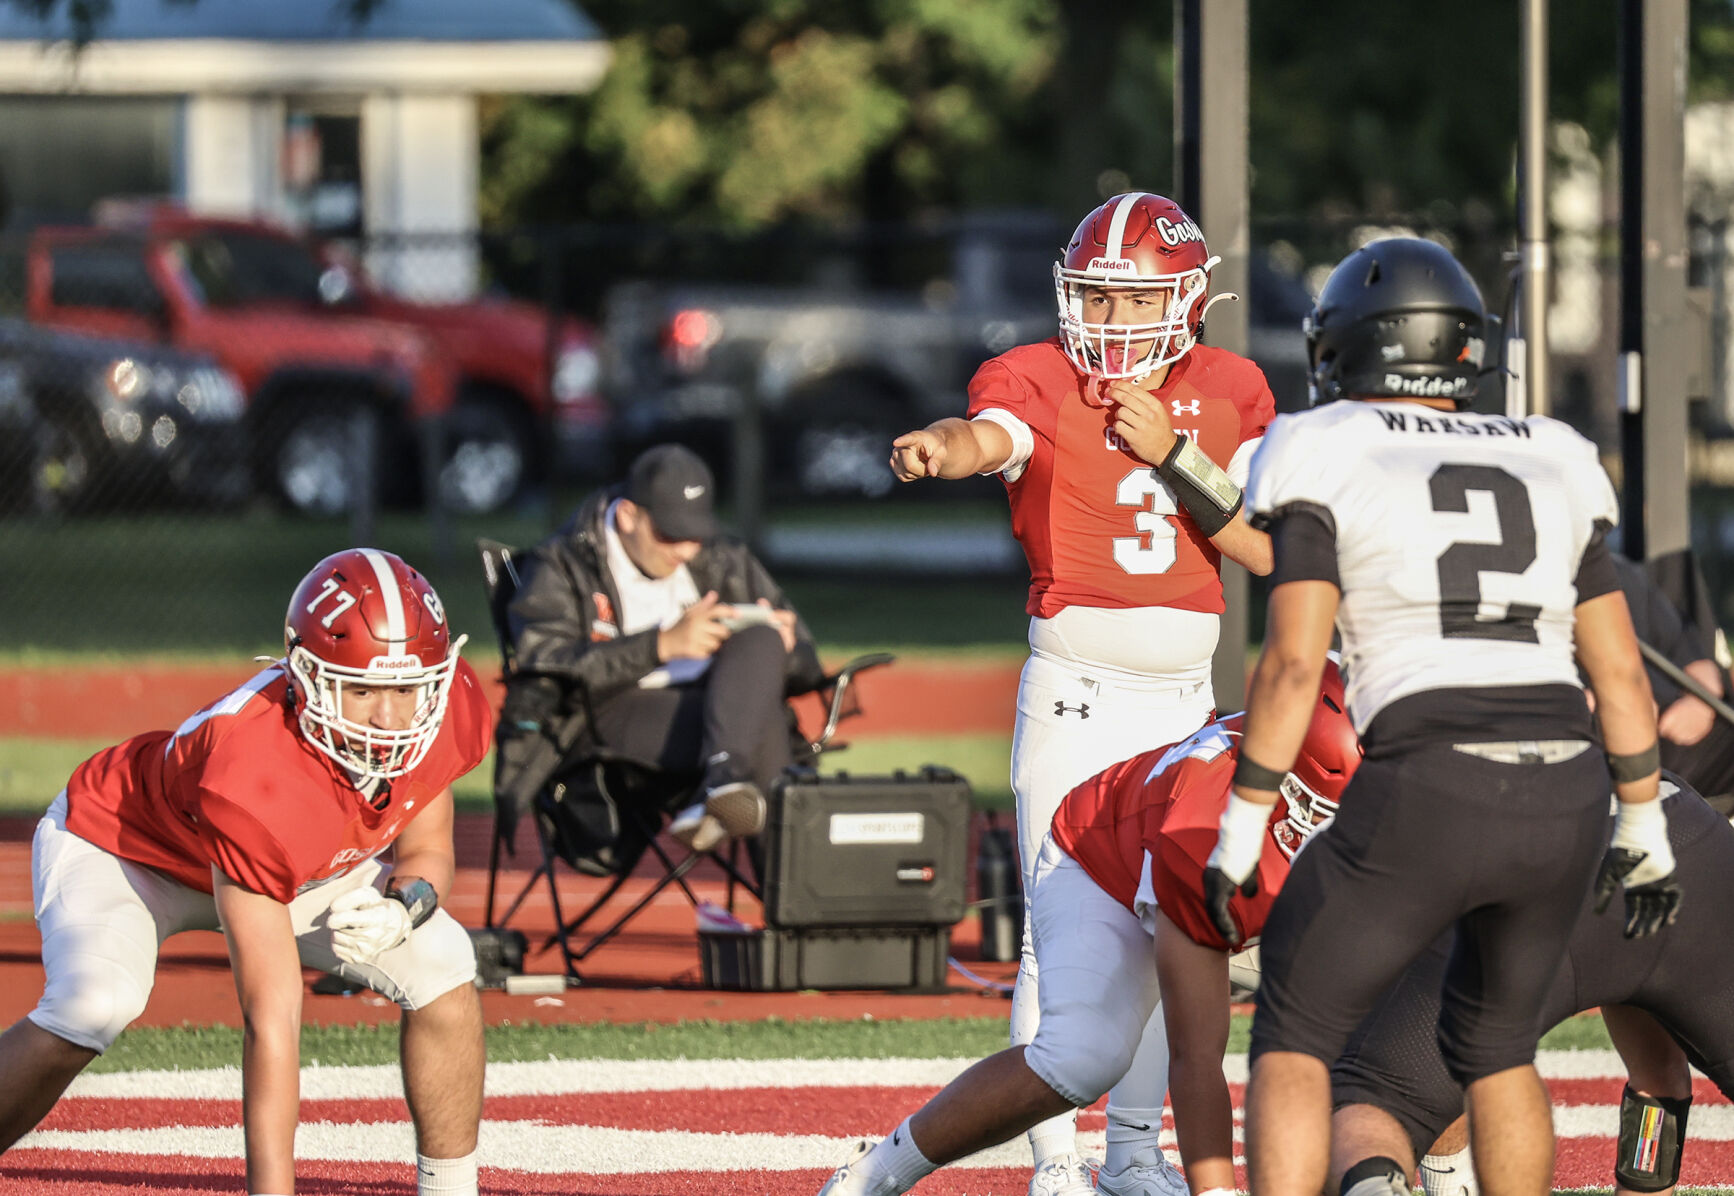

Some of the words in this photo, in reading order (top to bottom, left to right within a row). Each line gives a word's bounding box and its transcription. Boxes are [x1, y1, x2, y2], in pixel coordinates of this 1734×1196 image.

[1092, 259, 1130, 271] Riddell
[1375, 408, 1531, 438] WARSAW
[1112, 466, 1180, 576] 3
[1428, 463, 1542, 644] 2
[306, 578, 357, 629] 77
[376, 660, 416, 670] Riddell
